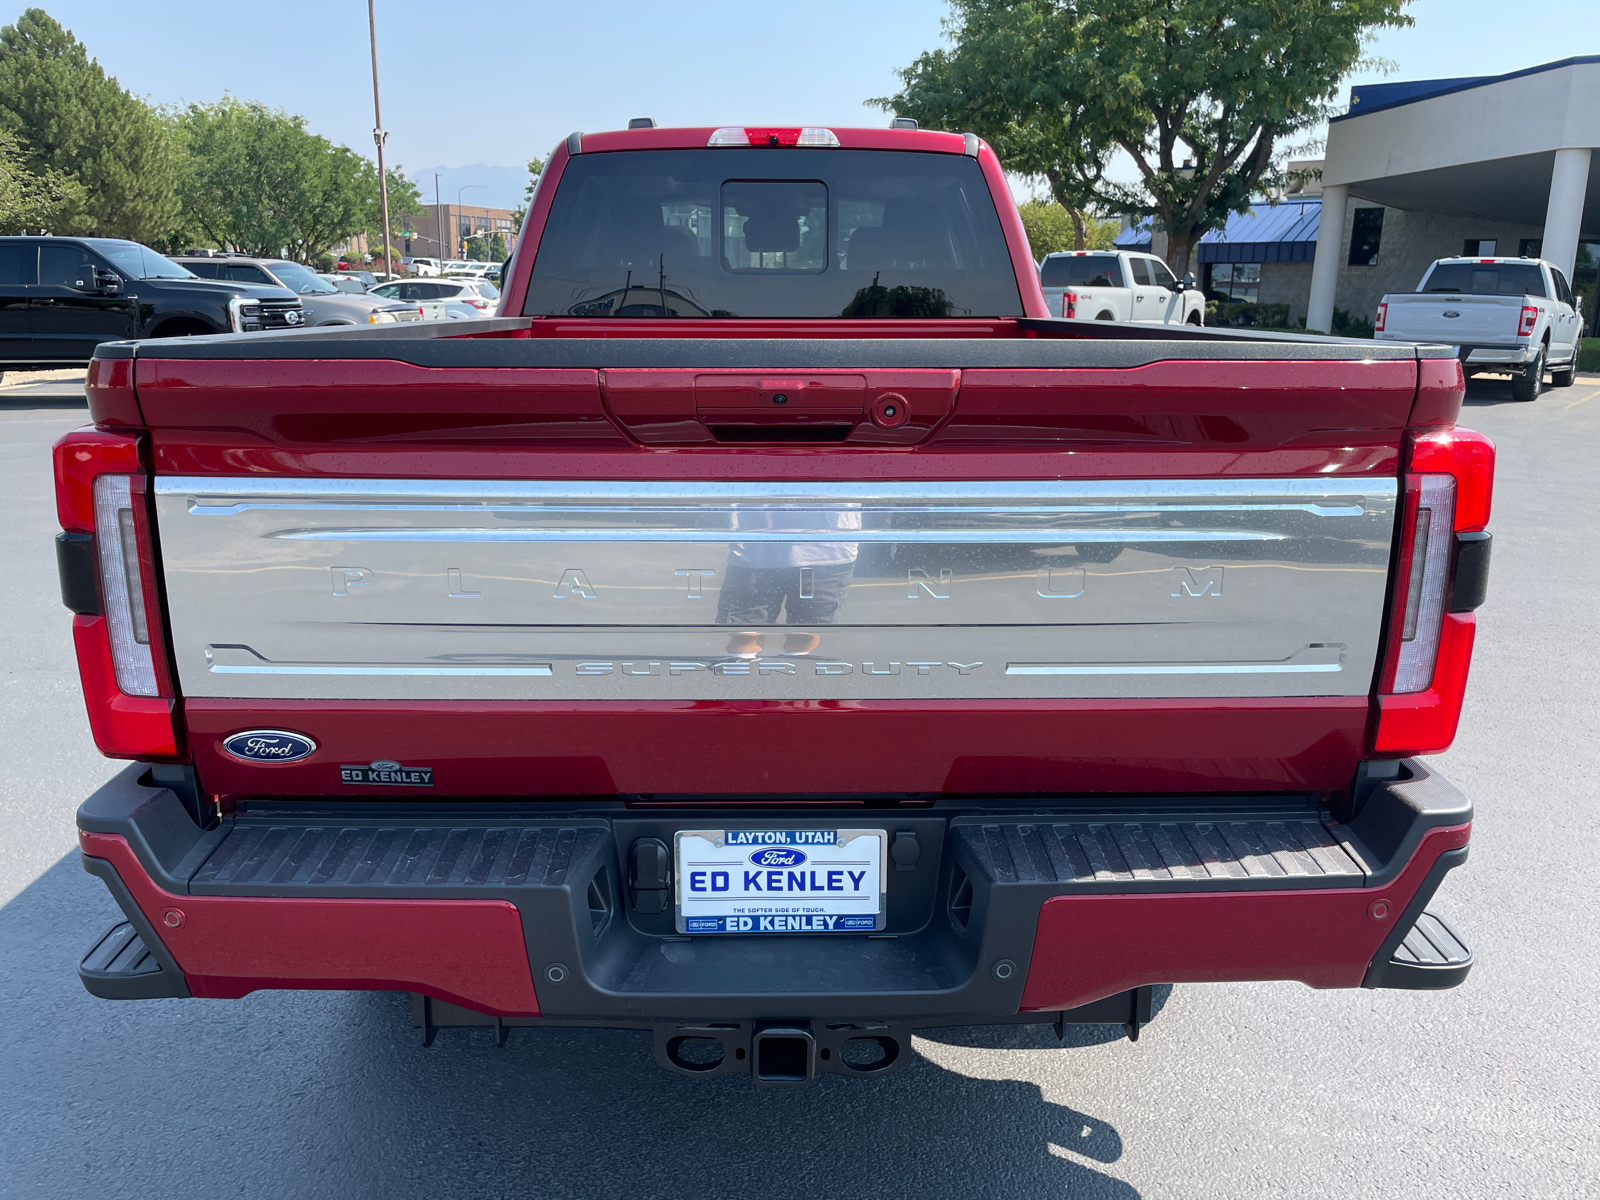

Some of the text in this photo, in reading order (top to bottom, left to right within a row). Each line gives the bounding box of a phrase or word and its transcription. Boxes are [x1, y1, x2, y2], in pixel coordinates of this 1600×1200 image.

[330, 566, 1225, 599] PLATINUM
[575, 661, 983, 676] SUPER DUTY
[244, 737, 293, 757] Ford
[341, 770, 431, 783] ED KENLEY
[727, 832, 834, 845] LAYTON, UTAH
[760, 850, 796, 866] Ford
[690, 870, 867, 892] ED KENLEY
[725, 915, 838, 931] ED KENLEY
